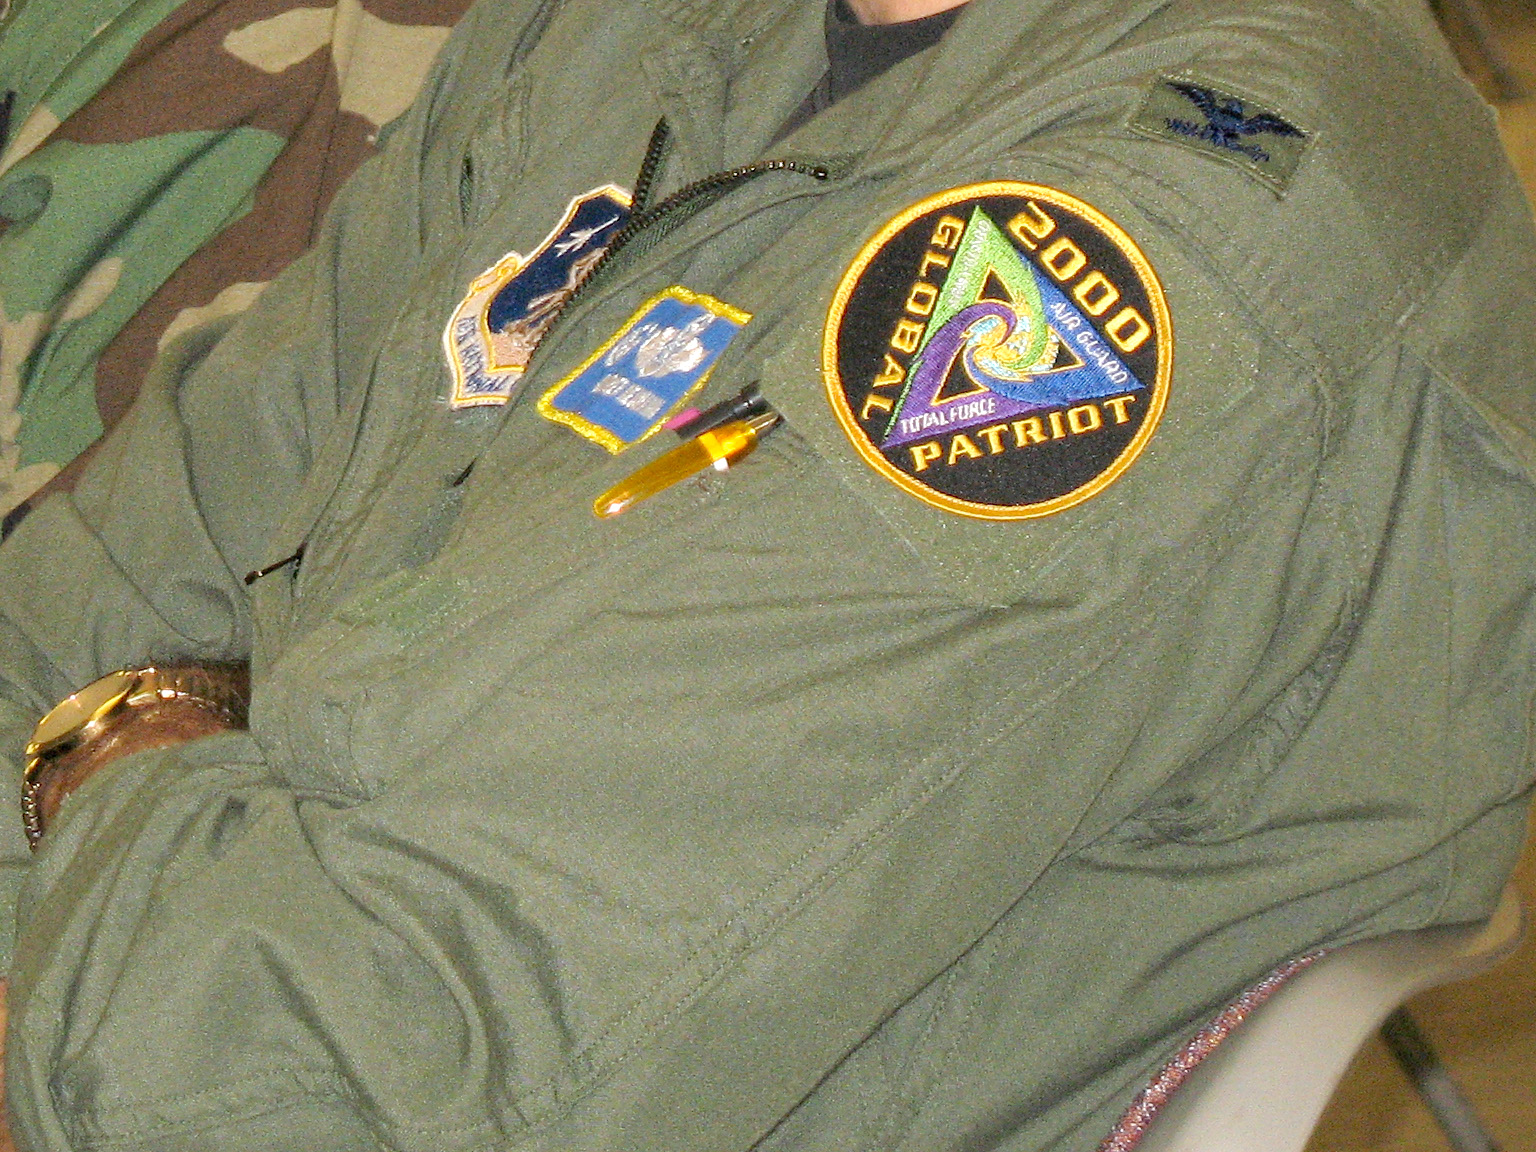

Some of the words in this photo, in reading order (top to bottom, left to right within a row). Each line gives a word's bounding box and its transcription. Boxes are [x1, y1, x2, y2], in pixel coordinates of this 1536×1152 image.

[861, 213, 966, 421] GLOBAL
[1006, 200, 1152, 353] 2000
[1050, 302, 1081, 331] AIR
[1076, 330, 1128, 384] GUARD
[900, 411, 950, 434] TOTAL
[949, 397, 996, 423] FORCE
[909, 395, 1136, 472] PATRIOT
